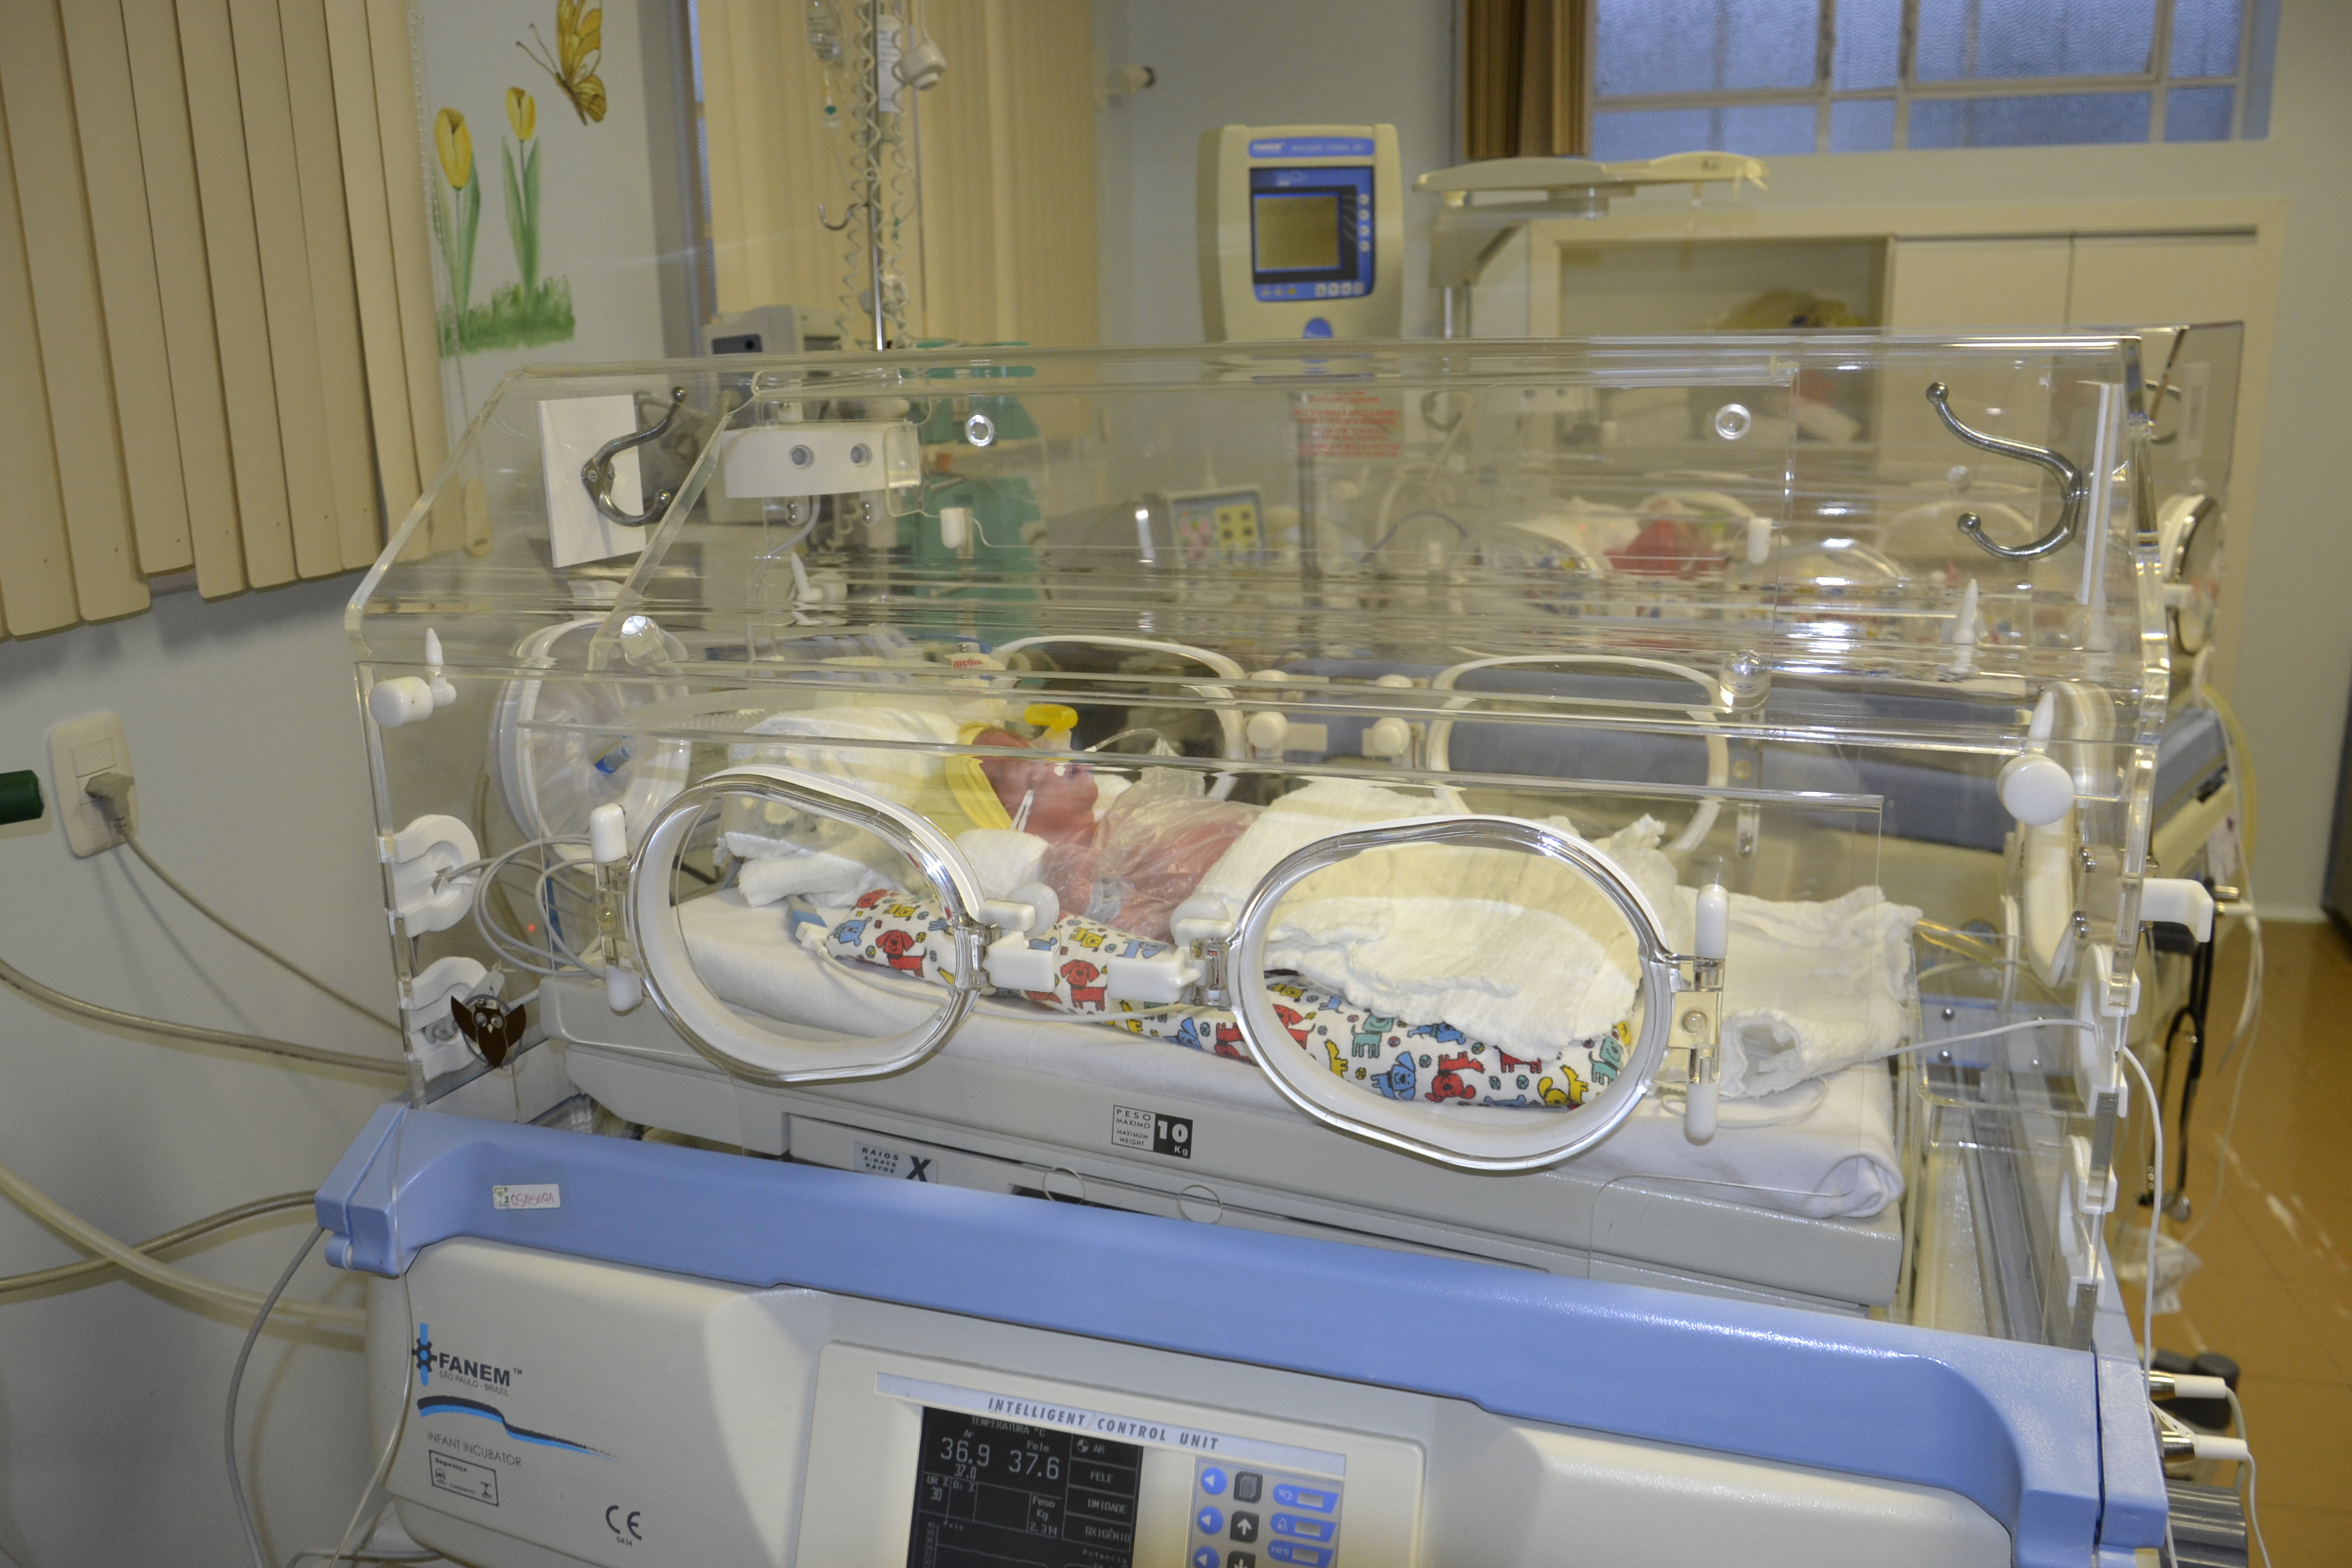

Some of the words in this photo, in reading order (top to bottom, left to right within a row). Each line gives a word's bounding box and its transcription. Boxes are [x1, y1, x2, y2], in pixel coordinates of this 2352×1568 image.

[1116, 1109, 1152, 1122] PESO
[1115, 1118, 1151, 1129] MÁXIMO
[1116, 1129, 1149, 1140] MAXIMUM
[1158, 1120, 1188, 1143] 10
[1120, 1137, 1145, 1147] WEIGHT
[862, 1147, 899, 1161] RAIOS
[1174, 1145, 1188, 1157] Kg
[864, 1156, 896, 1168] X-RAYS
[865, 1162, 895, 1174] RAYOS
[905, 1155, 932, 1183] X
[439, 1352, 510, 1387] FANEM
[439, 1370, 454, 1381] SÃO
[455, 1375, 478, 1388] PAULO
[484, 1383, 509, 1396] BRAZIL
[971, 1417, 1030, 1435] TEMPERATURA
[987, 1398, 1085, 1426] INTELLIGENT
[1097, 1418, 1166, 1441] CONTROL
[1179, 1433, 1219, 1450] UNIT
[964, 1429, 975, 1439] Ar
[427, 1431, 460, 1450] INFANT
[463, 1441, 522, 1468] INCUBATOR
[941, 1437, 990, 1467] 36.9
[1026, 1439, 1050, 1452] Pele
[1093, 1444, 1105, 1454] AR
[954, 1463, 977, 1480] 37.0
[1009, 1449, 1060, 1480] 37.6
[926, 1475, 938, 1485] UR
[1090, 1471, 1113, 1484] PELE
[930, 1486, 943, 1501] 30
[1032, 1496, 1055, 1508] Peso
[1088, 1498, 1127, 1515] UMIDADE
[1036, 1509, 1048, 1521] Kg
[606, 1505, 642, 1541] CE
[1030, 1522, 1058, 1536] 2.314
[1085, 1526, 1130, 1544] OXIGÊNIO
